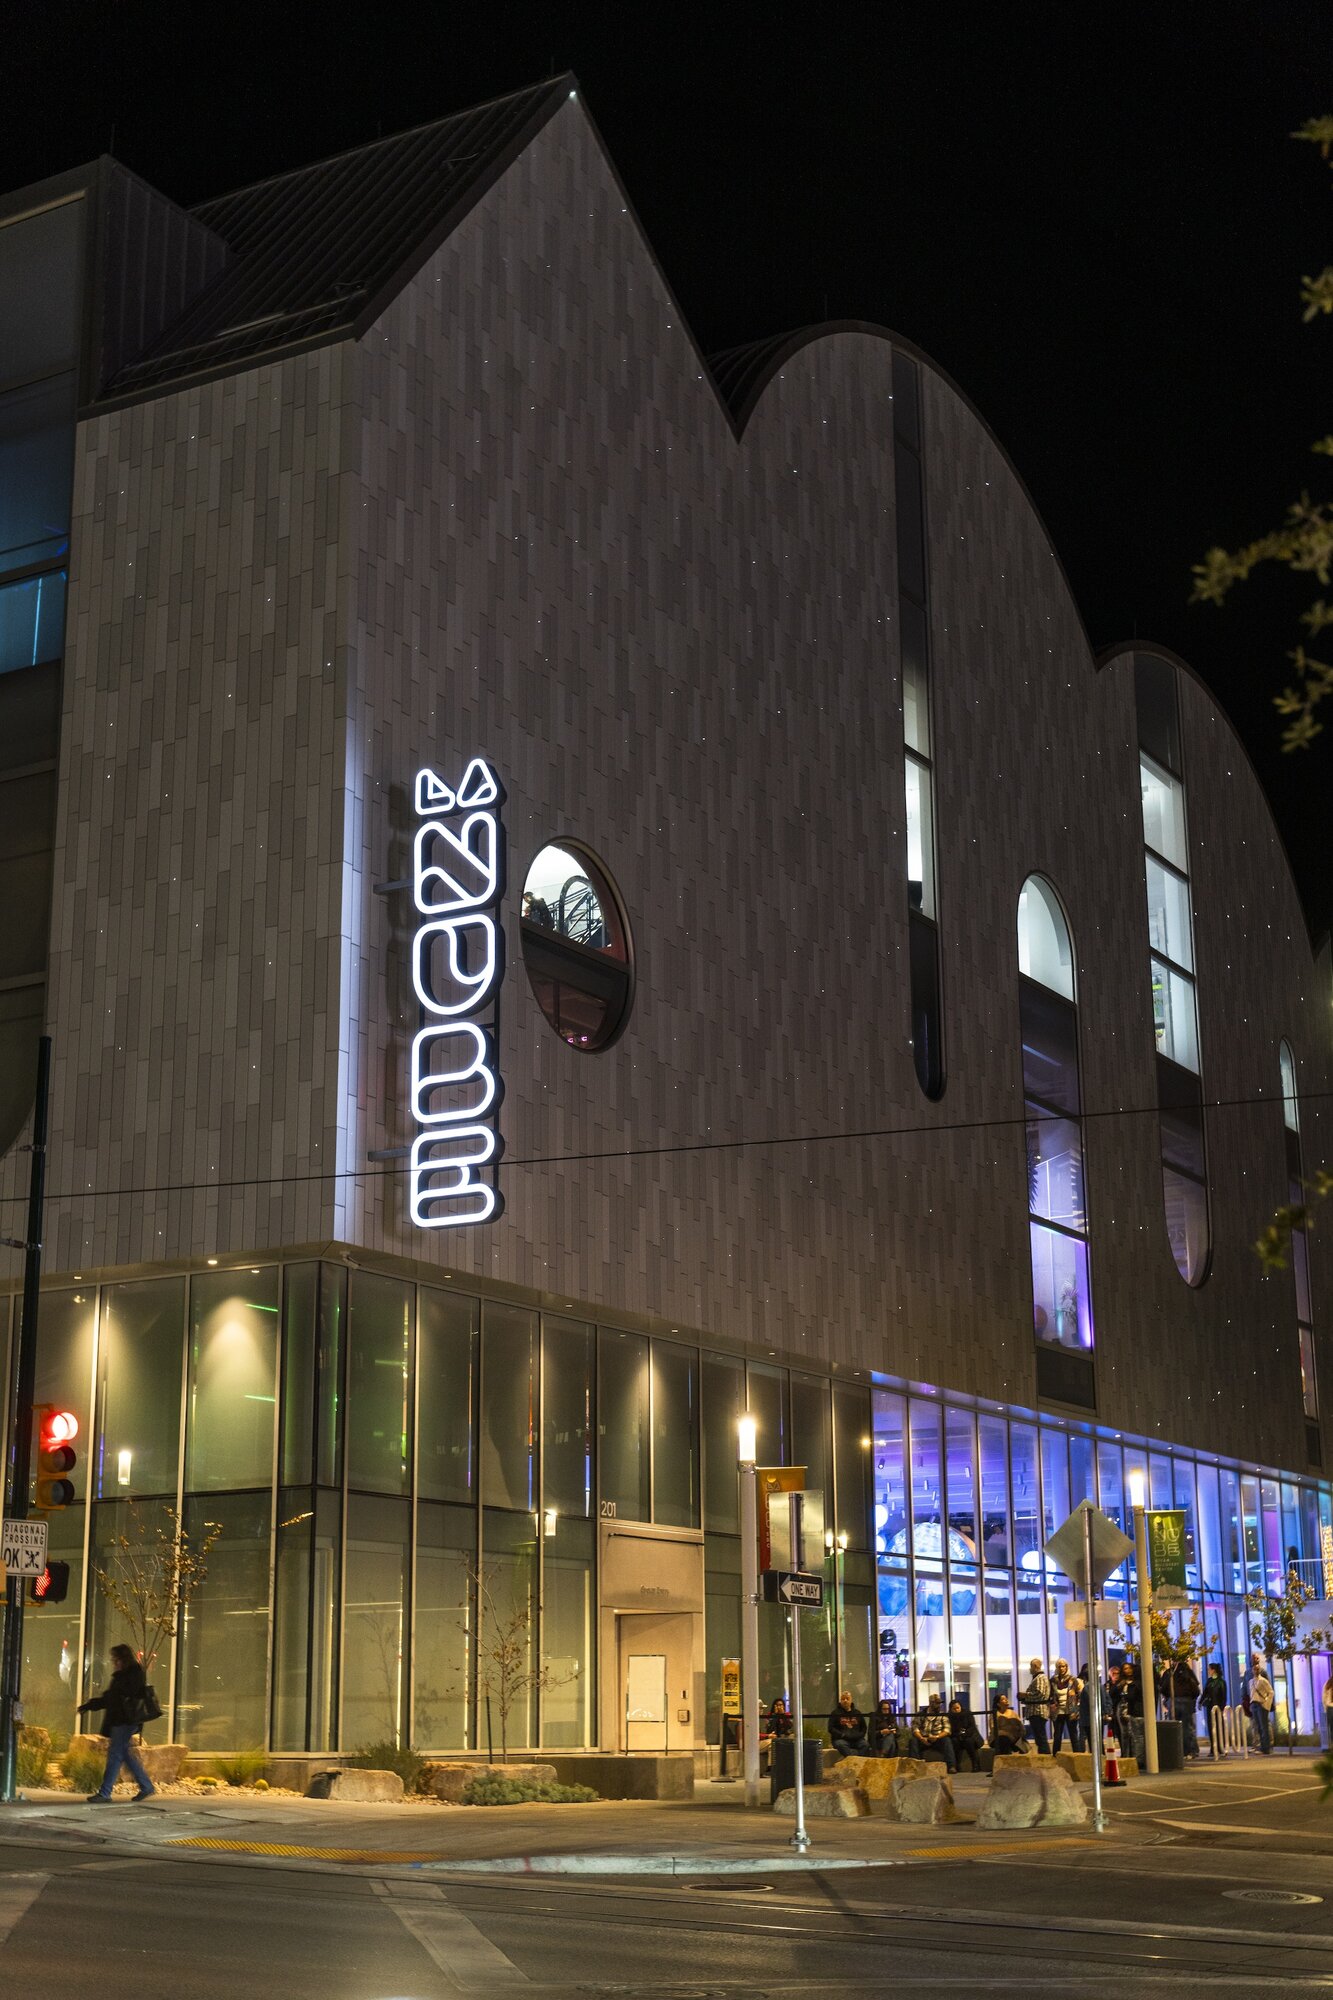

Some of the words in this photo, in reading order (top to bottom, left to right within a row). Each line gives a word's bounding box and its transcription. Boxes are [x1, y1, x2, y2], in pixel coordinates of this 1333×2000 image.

[601, 1500, 617, 1517] 201
[5, 1523, 45, 1535] DIAGONAL
[5, 1534, 44, 1545] CROSSING
[4, 1547, 20, 1568] OK
[791, 1583, 804, 1595] ONE
[805, 1584, 818, 1597] WAY
